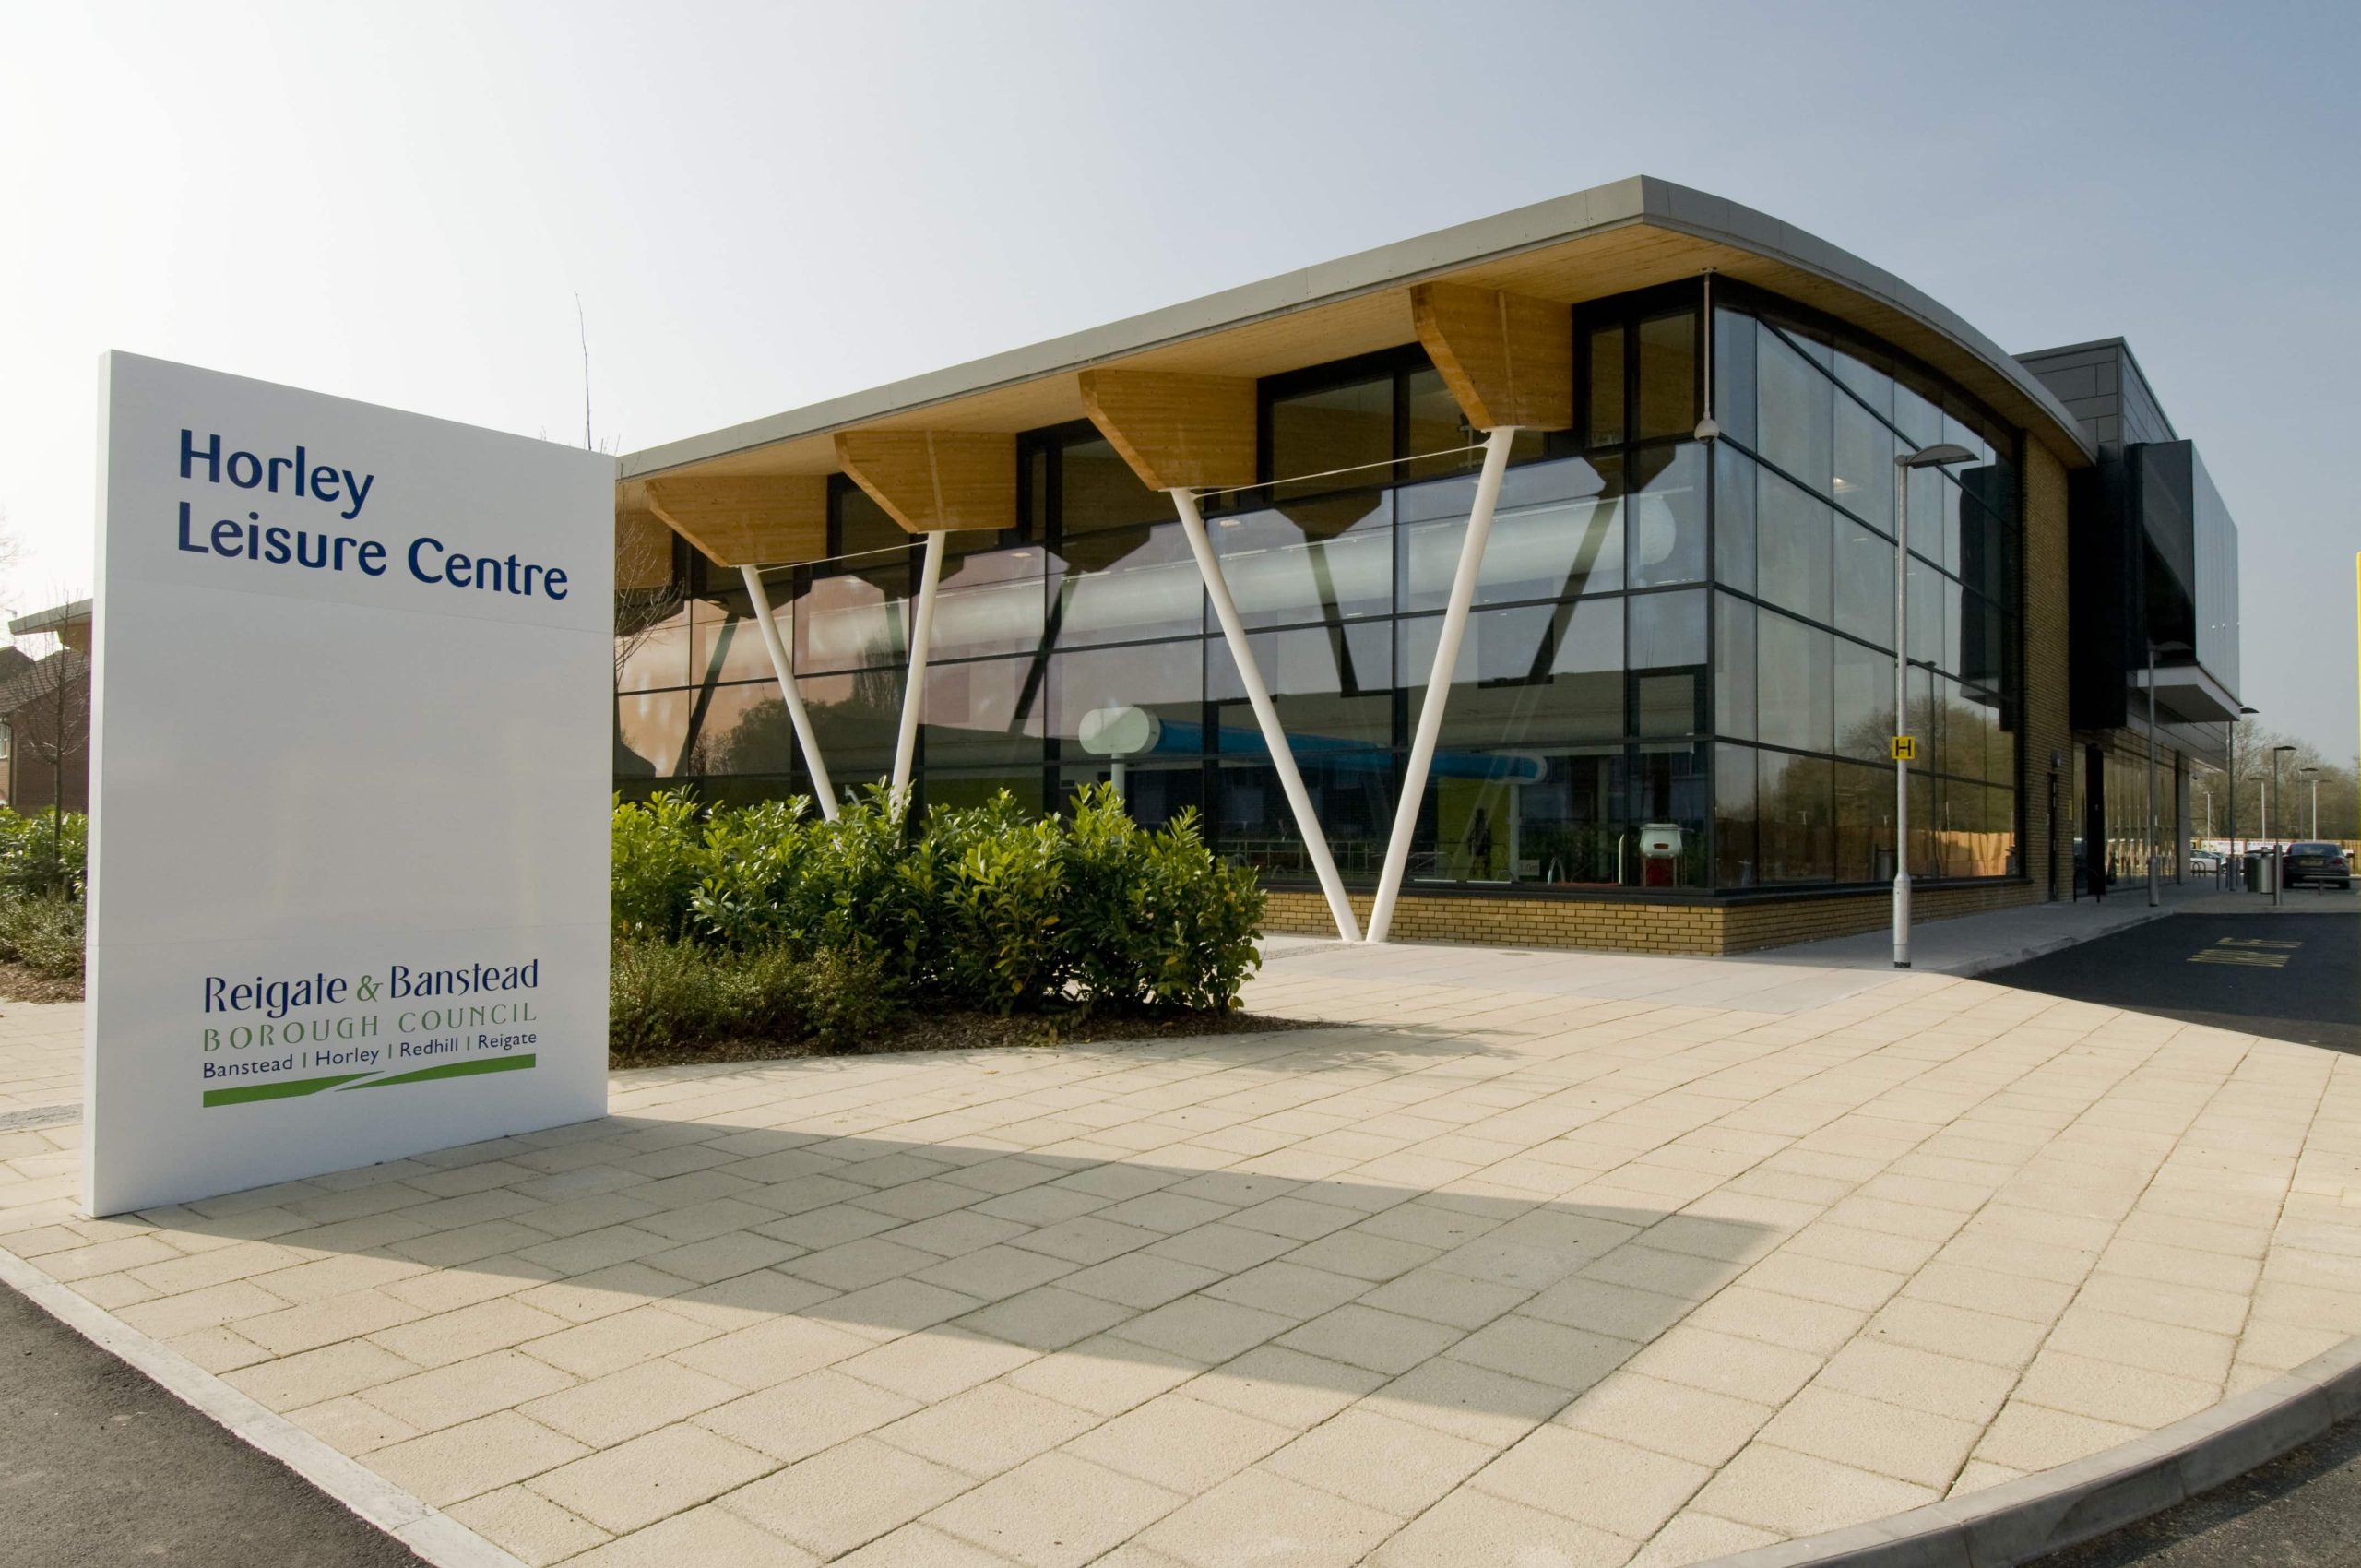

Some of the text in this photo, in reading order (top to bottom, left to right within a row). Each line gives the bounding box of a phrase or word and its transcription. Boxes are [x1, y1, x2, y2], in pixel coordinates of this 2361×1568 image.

[179, 428, 375, 520] Horley
[178, 500, 568, 600] Leisure Centre
[1895, 739, 1912, 756] H
[204, 958, 539, 1018] Reigate & Banstead
[204, 1002, 537, 1052] BOROUGH COUNCIL
[203, 1032, 537, 1079] Banstead Horley Redhill Reigate
